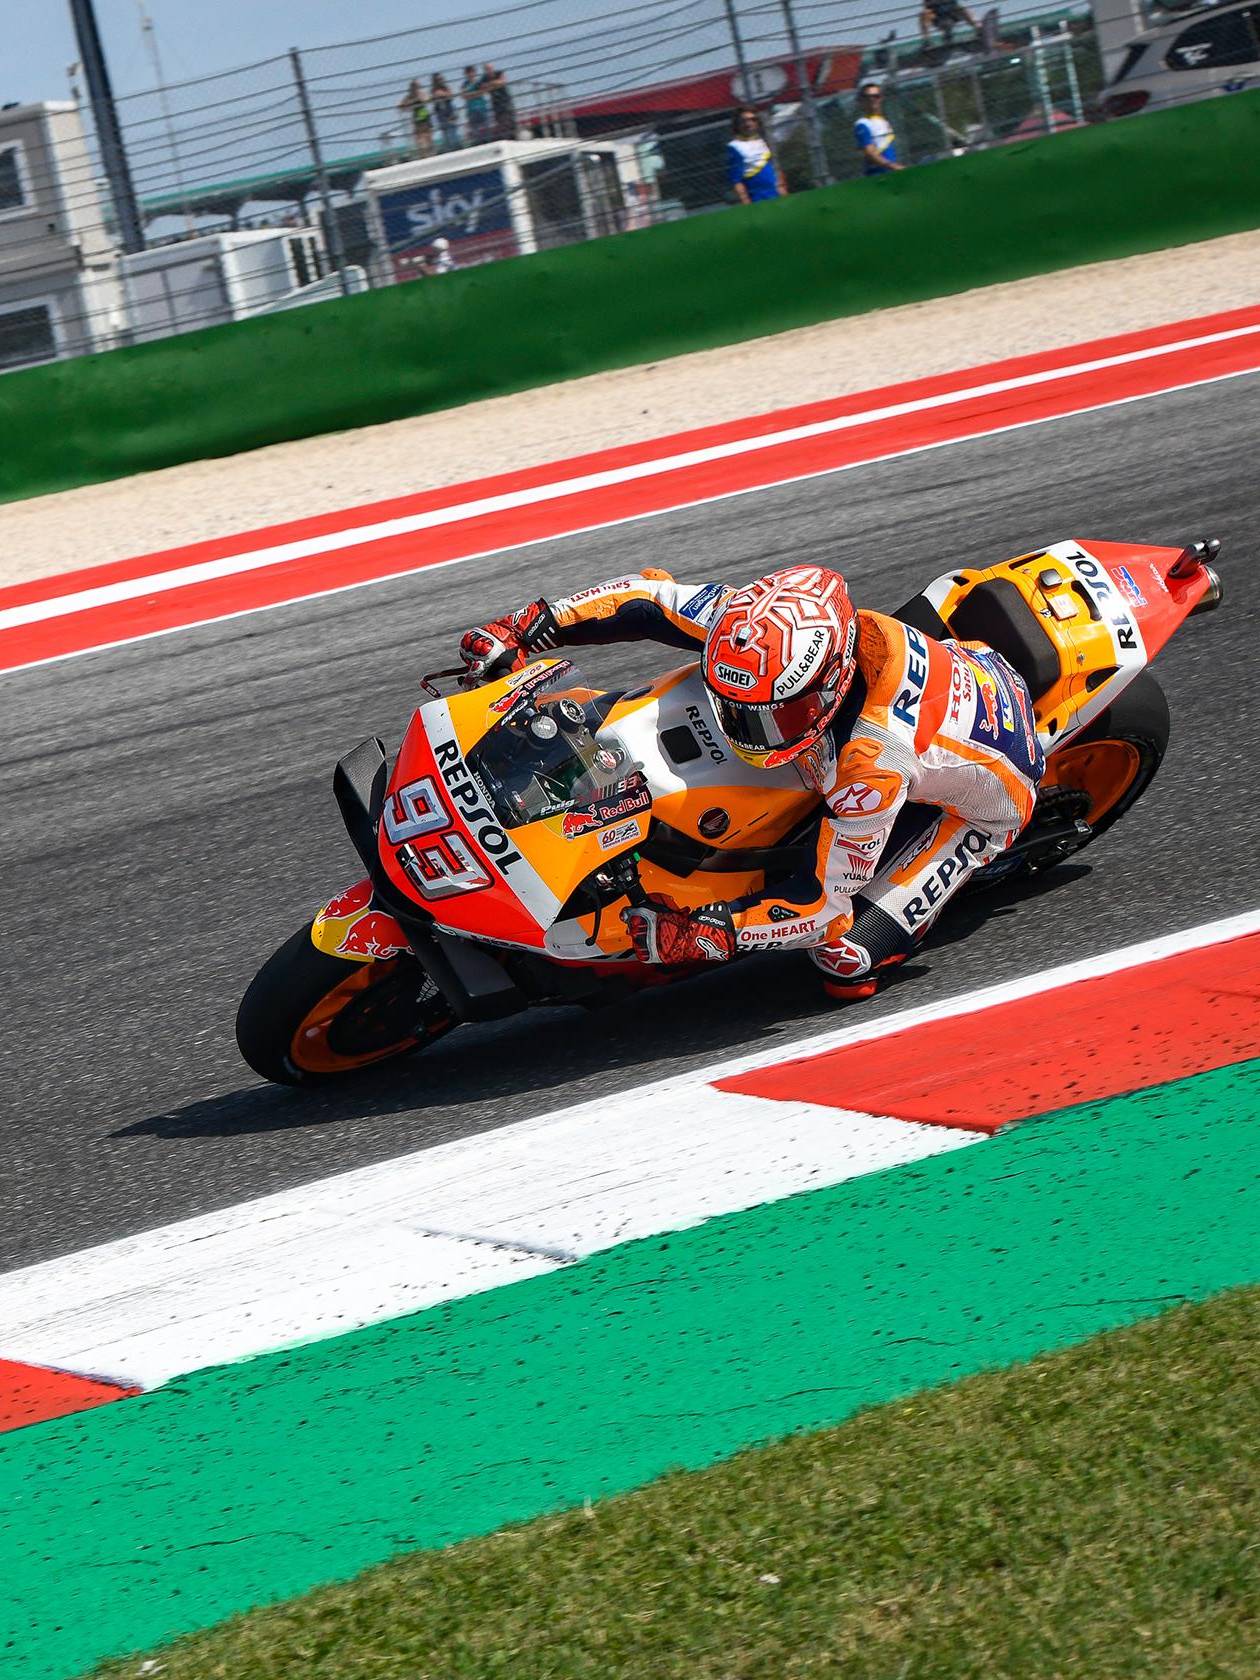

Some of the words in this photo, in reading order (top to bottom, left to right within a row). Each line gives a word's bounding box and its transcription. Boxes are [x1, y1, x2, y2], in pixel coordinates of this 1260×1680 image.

[1065, 550, 1137, 649] RESOL
[717, 664, 752, 688] SHOEI
[776, 629, 825, 696] PULL&BEAR
[893, 624, 927, 727] REP
[748, 702, 785, 712] WINGS
[433, 738, 523, 877] REPSOL
[473, 770, 497, 810] HONDA
[600, 801, 626, 820] Red
[624, 791, 651, 813] Bull
[383, 774, 495, 903] 93
[601, 829, 617, 846] 60
[740, 931, 768, 942] One
